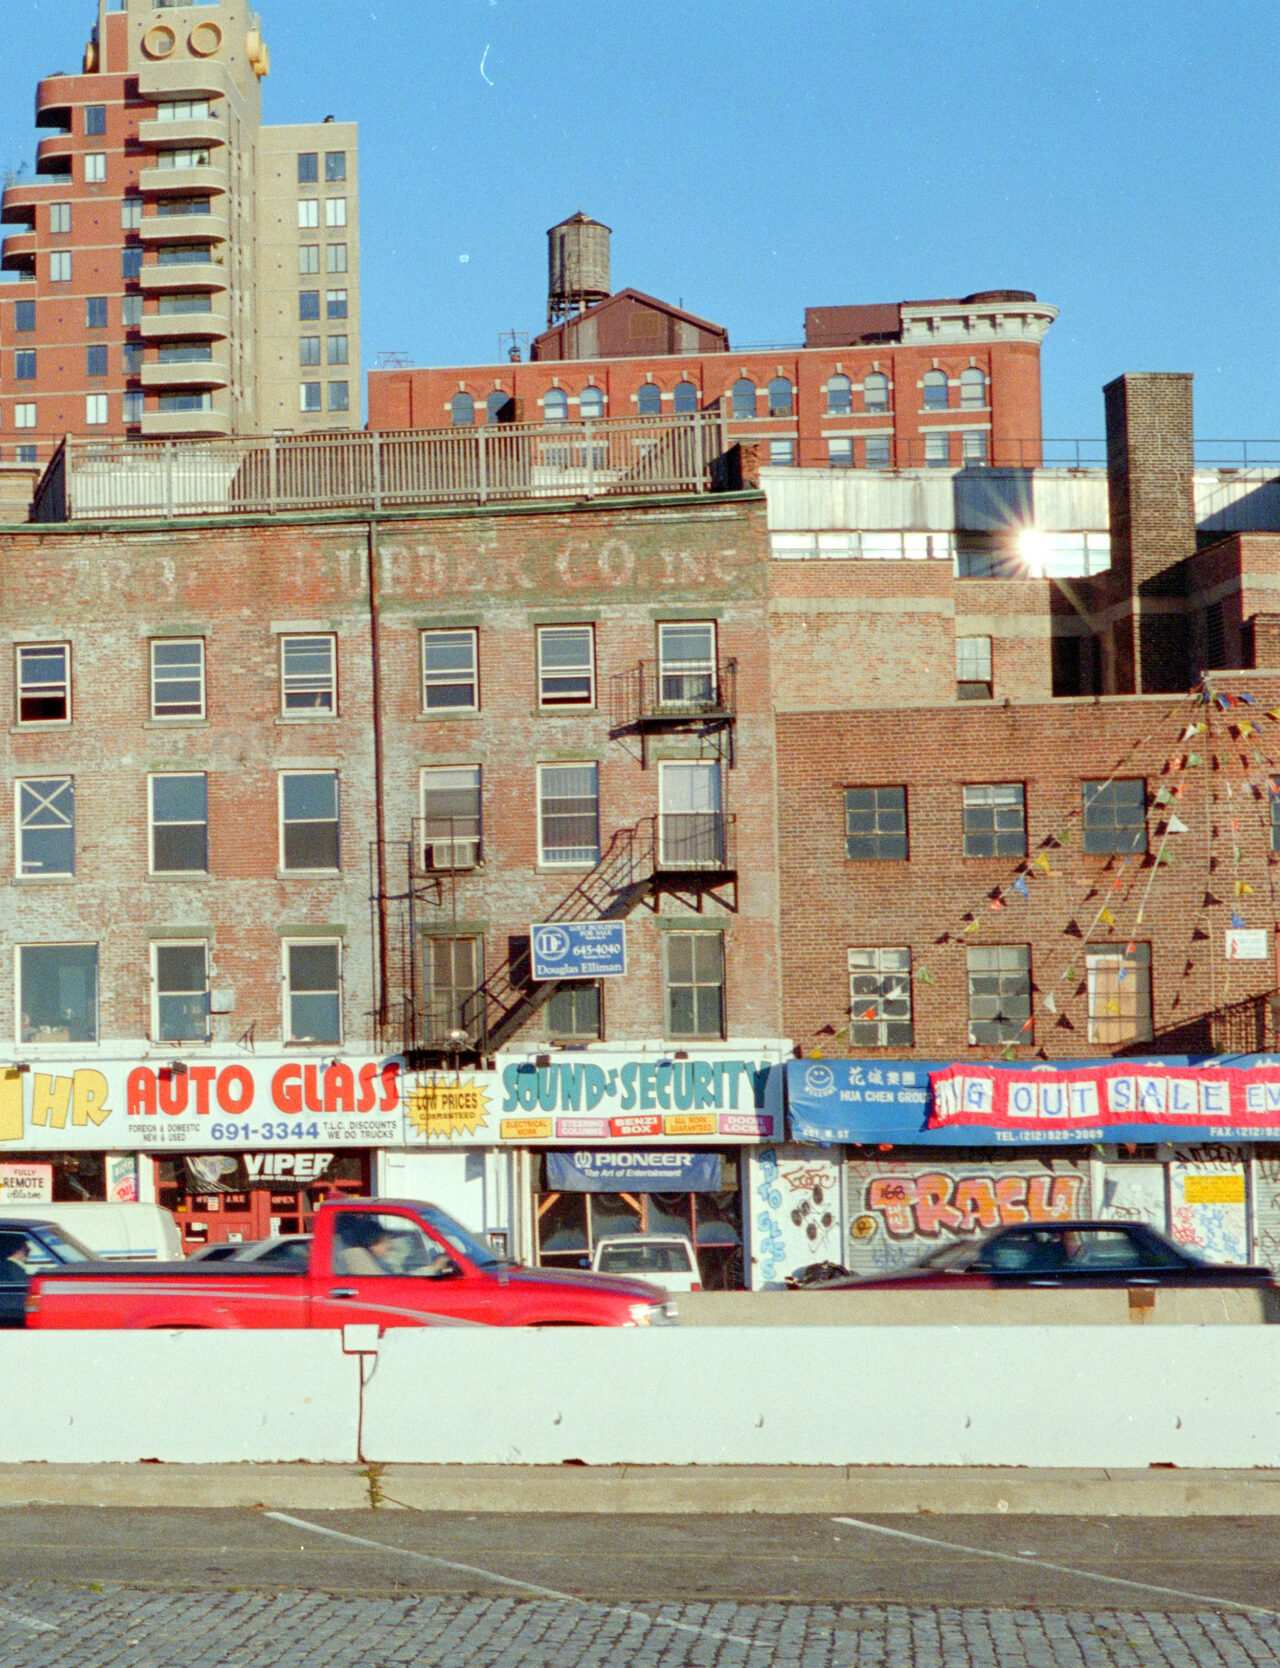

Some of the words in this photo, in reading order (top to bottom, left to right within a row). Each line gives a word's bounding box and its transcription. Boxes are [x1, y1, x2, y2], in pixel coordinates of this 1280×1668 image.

[572, 943, 621, 956] 645-4040
[537, 963, 579, 976] Douglas
[582, 961, 622, 973] Elliman
[127, 1064, 254, 1115] AUTO
[271, 1062, 400, 1114] GLASS
[502, 1063, 606, 1113] SOUND
[621, 1060, 772, 1111] SECURITY
[32, 1068, 112, 1129] HR
[416, 1096, 438, 1111] LOW
[442, 1092, 478, 1110] PRICES
[840, 1090, 862, 1102] HUA
[865, 1090, 894, 1103] CHEN
[898, 1091, 933, 1104] GROUP
[1014, 1087, 1093, 1115] OUT
[1114, 1079, 1224, 1111] SALE
[419, 1111, 476, 1121] GUARANTEED
[615, 1116, 658, 1127] BENZI
[728, 1115, 764, 1124] DOOR
[128, 1124, 157, 1133] FOREIGN
[167, 1123, 200, 1132] DOMESTIC
[349, 1120, 397, 1129] DISCOUNTS
[505, 1120, 547, 1128] ELECTRICAL
[621, 1125, 652, 1134] BOX
[724, 1124, 767, 1133] LOCKS
[210, 1122, 319, 1140] 691-3344
[328, 1131, 341, 1139] WE
[345, 1130, 357, 1139] DO
[361, 1130, 394, 1139] TRUCKS
[517, 1128, 537, 1136] WORK
[143, 1133, 157, 1142] NEW
[168, 1133, 186, 1142] USED
[242, 1153, 334, 1176] VIPER
[594, 1152, 692, 1166] PIONEER
[14, 1168, 37, 1176] FULLY
[584, 1169, 599, 1177] The
[600, 1169, 614, 1177] Art
[615, 1168, 625, 1177] of
[625, 1168, 682, 1178] Entertainment
[4, 1176, 45, 1189] REMOTE
